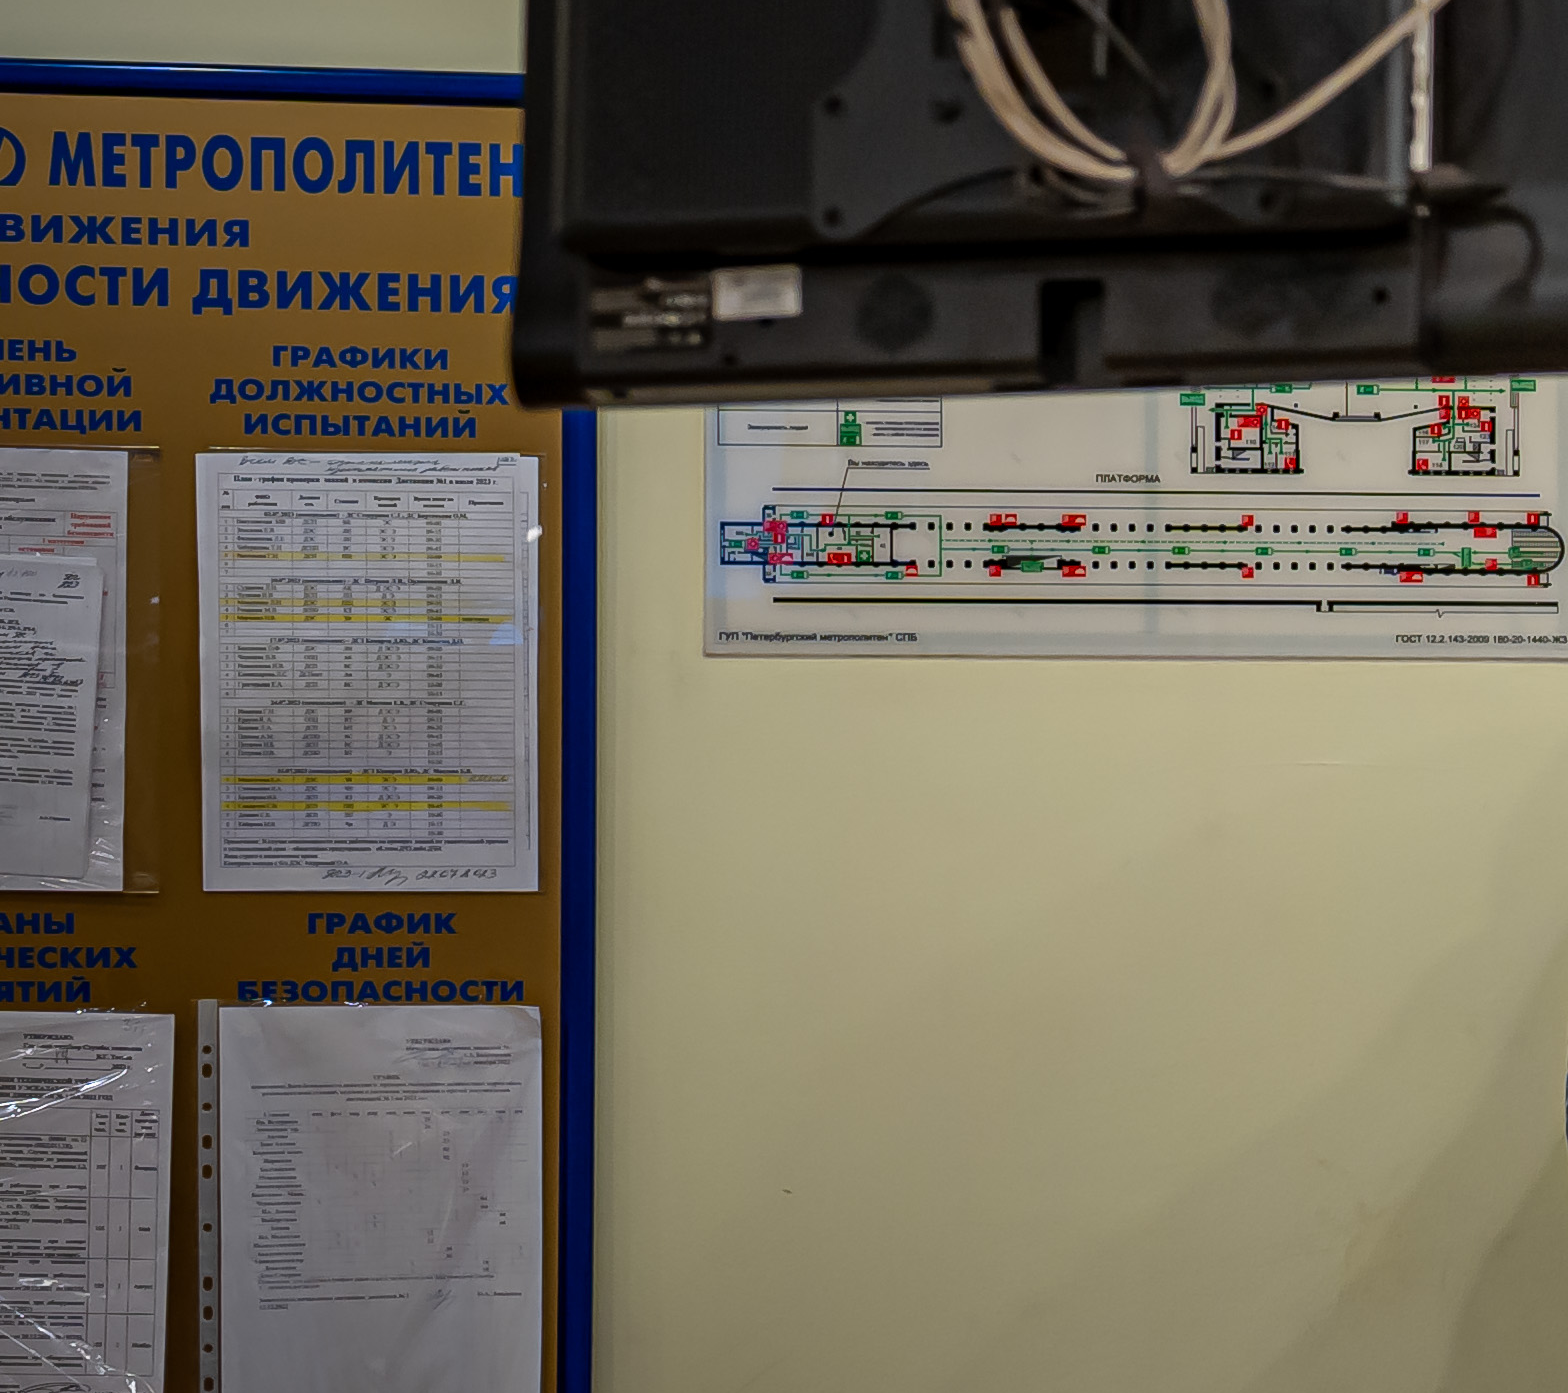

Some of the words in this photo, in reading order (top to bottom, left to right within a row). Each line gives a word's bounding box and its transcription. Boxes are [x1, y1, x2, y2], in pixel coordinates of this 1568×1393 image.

[49, 131, 522, 197] МЕТРОПОЛИТЕН
[0, 264, 168, 306] ОСТИ
[192, 269, 517, 316] ДВИЖЕНИЯ
[0, 339, 76, 362] ЕНЬ
[273, 345, 448, 370] ГРАФИКИ
[210, 378, 508, 405] ДОЛЖНОСТНЫХ
[244, 410, 477, 439] ИСПЫТАНИЙ
[1096, 474, 1160, 483] ПЛАТФОРМА
[719, 632, 739, 641] ГУП
[742, 632, 817, 642] "Петербургский
[820, 633, 893, 642] метрополитен"
[896, 633, 917, 641] СПБ
[1396, 635, 1422, 643] ГОСТ
[1426, 635, 1489, 643] 12.2.143-2009
[308, 912, 456, 934] ГРАФИК
[332, 946, 430, 972] ДНЕЙ
[234, 980, 524, 1007] БЕЗОПАСНОСТИ
